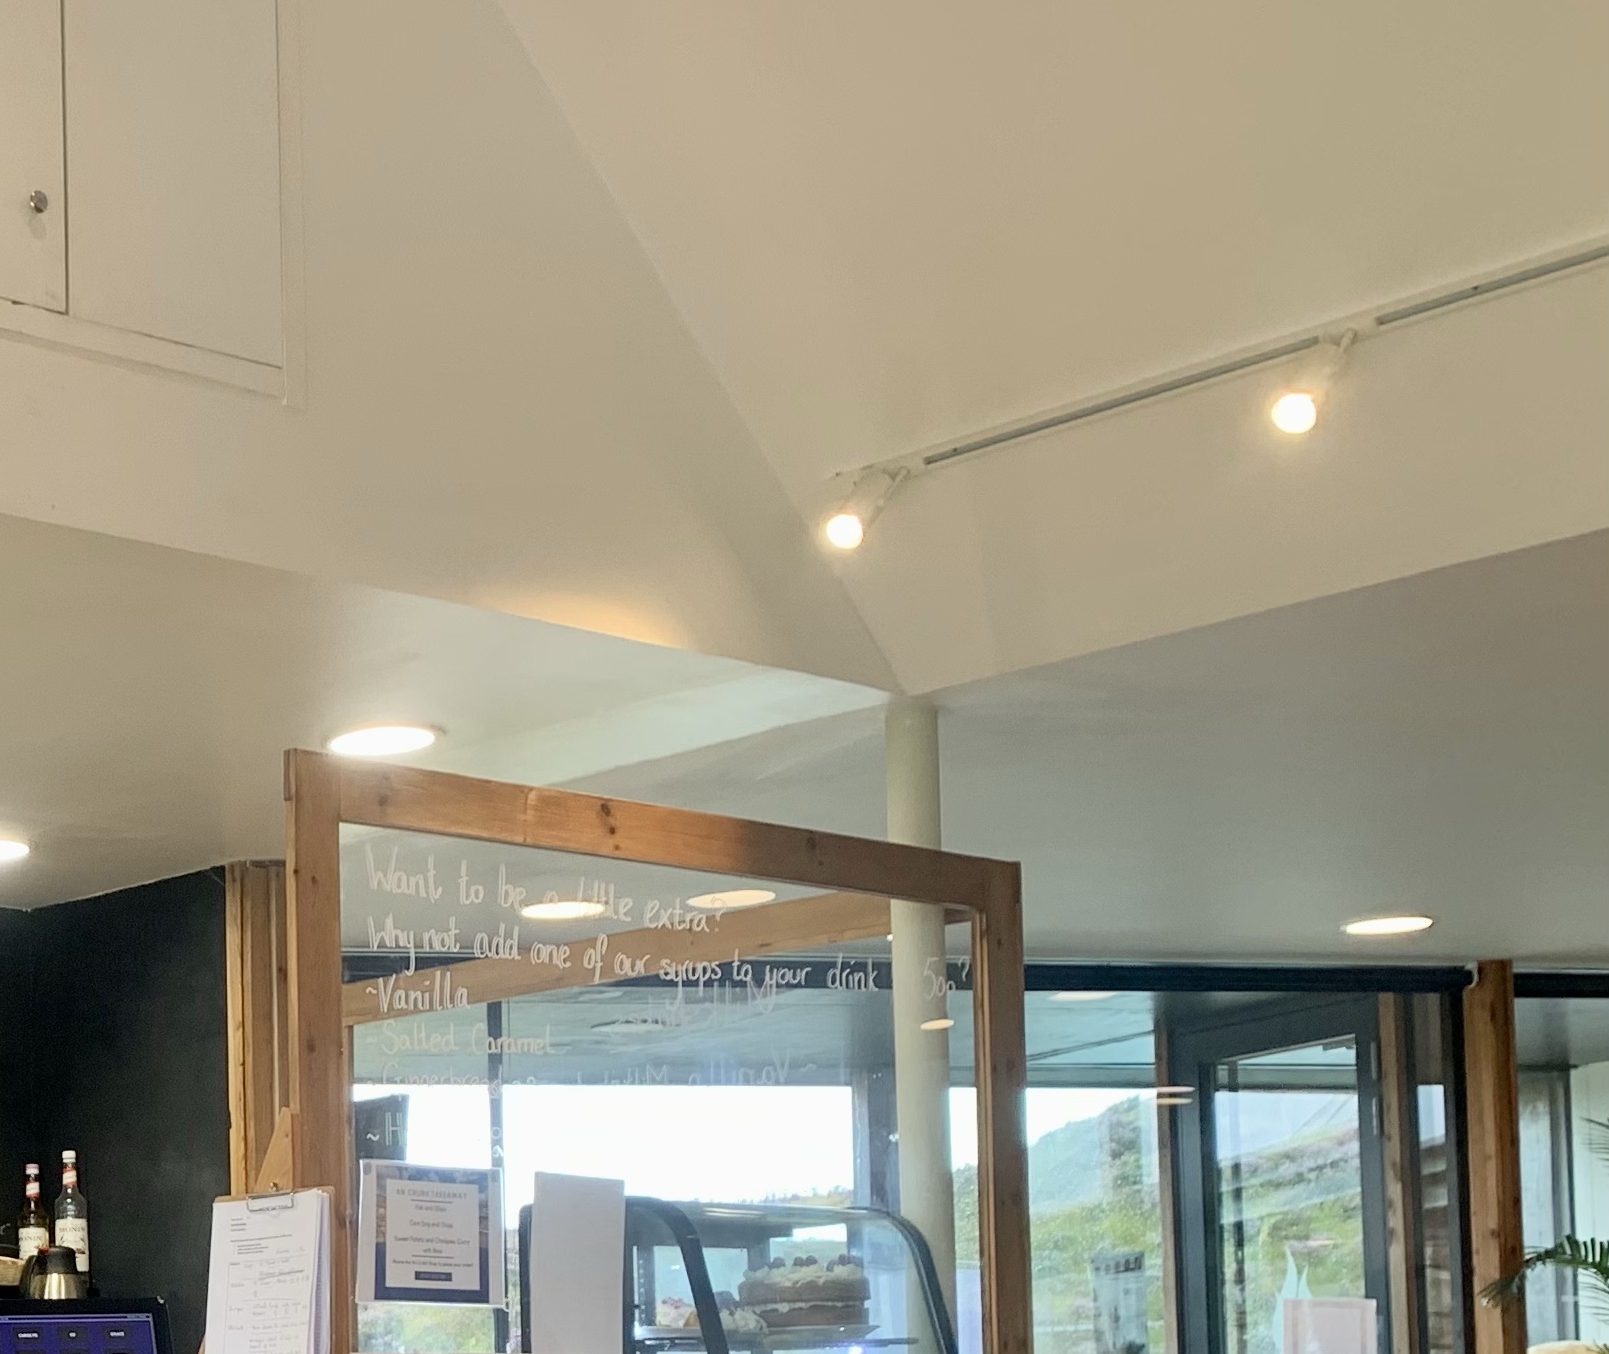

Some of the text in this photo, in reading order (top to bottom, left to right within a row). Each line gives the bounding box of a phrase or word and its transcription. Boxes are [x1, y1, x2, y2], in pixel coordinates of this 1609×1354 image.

[365, 843, 442, 903] Want
[458, 859, 484, 904] to
[499, 863, 527, 911] be
[643, 896, 727, 933] extra?
[367, 913, 880, 1012] Why not add one of our syrups to your drink
[381, 1020, 559, 1056] Salted Caramel
